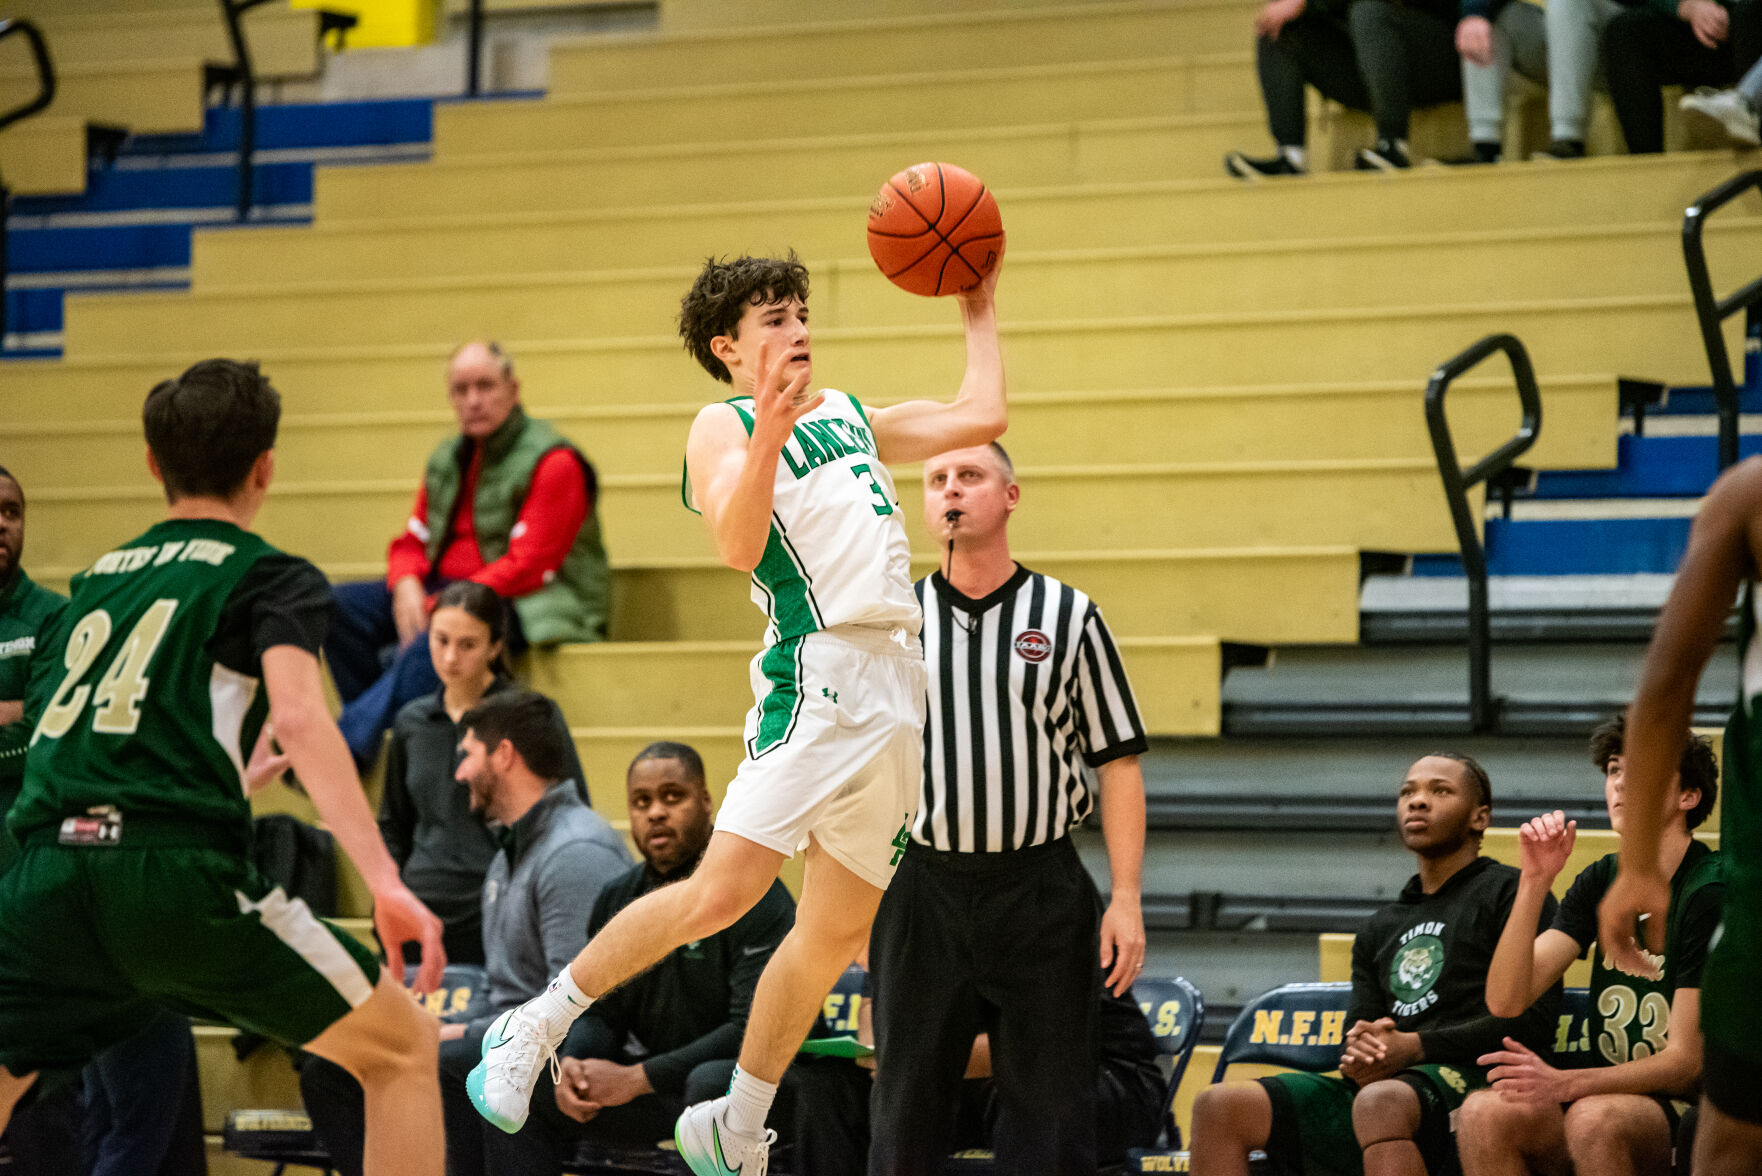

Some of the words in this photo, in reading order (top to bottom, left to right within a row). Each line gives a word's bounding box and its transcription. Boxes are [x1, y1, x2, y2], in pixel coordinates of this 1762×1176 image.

[850, 463, 893, 516] 3
[29, 598, 179, 745] 24
[1399, 921, 1446, 945] TIMON
[1392, 989, 1439, 1017] TIGERS
[1598, 985, 1671, 1065] 33
